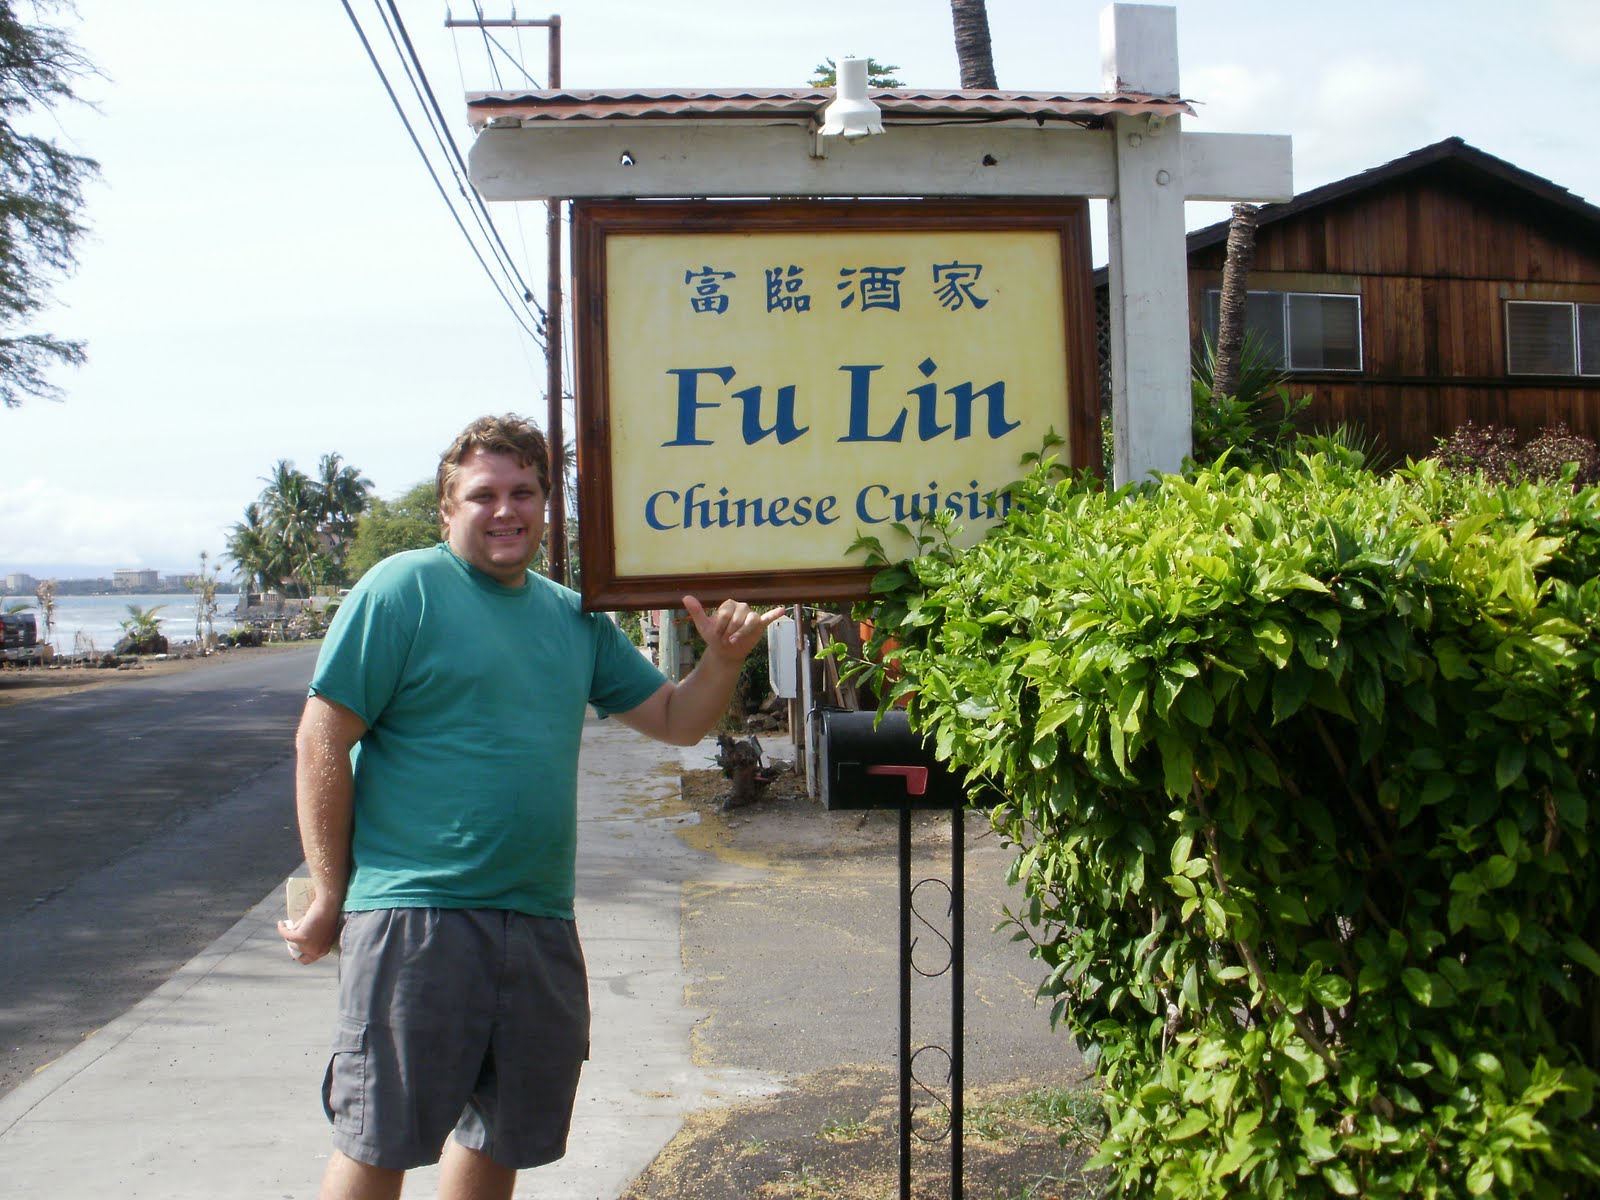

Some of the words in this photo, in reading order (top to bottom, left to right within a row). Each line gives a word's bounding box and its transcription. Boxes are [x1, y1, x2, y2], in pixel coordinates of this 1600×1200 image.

[685, 260, 989, 315] 富臨酒家
[661, 365, 810, 447] Fu
[837, 357, 1021, 443] Lin
[645, 483, 841, 530] Chinese
[856, 480, 1026, 525] Cuisin
